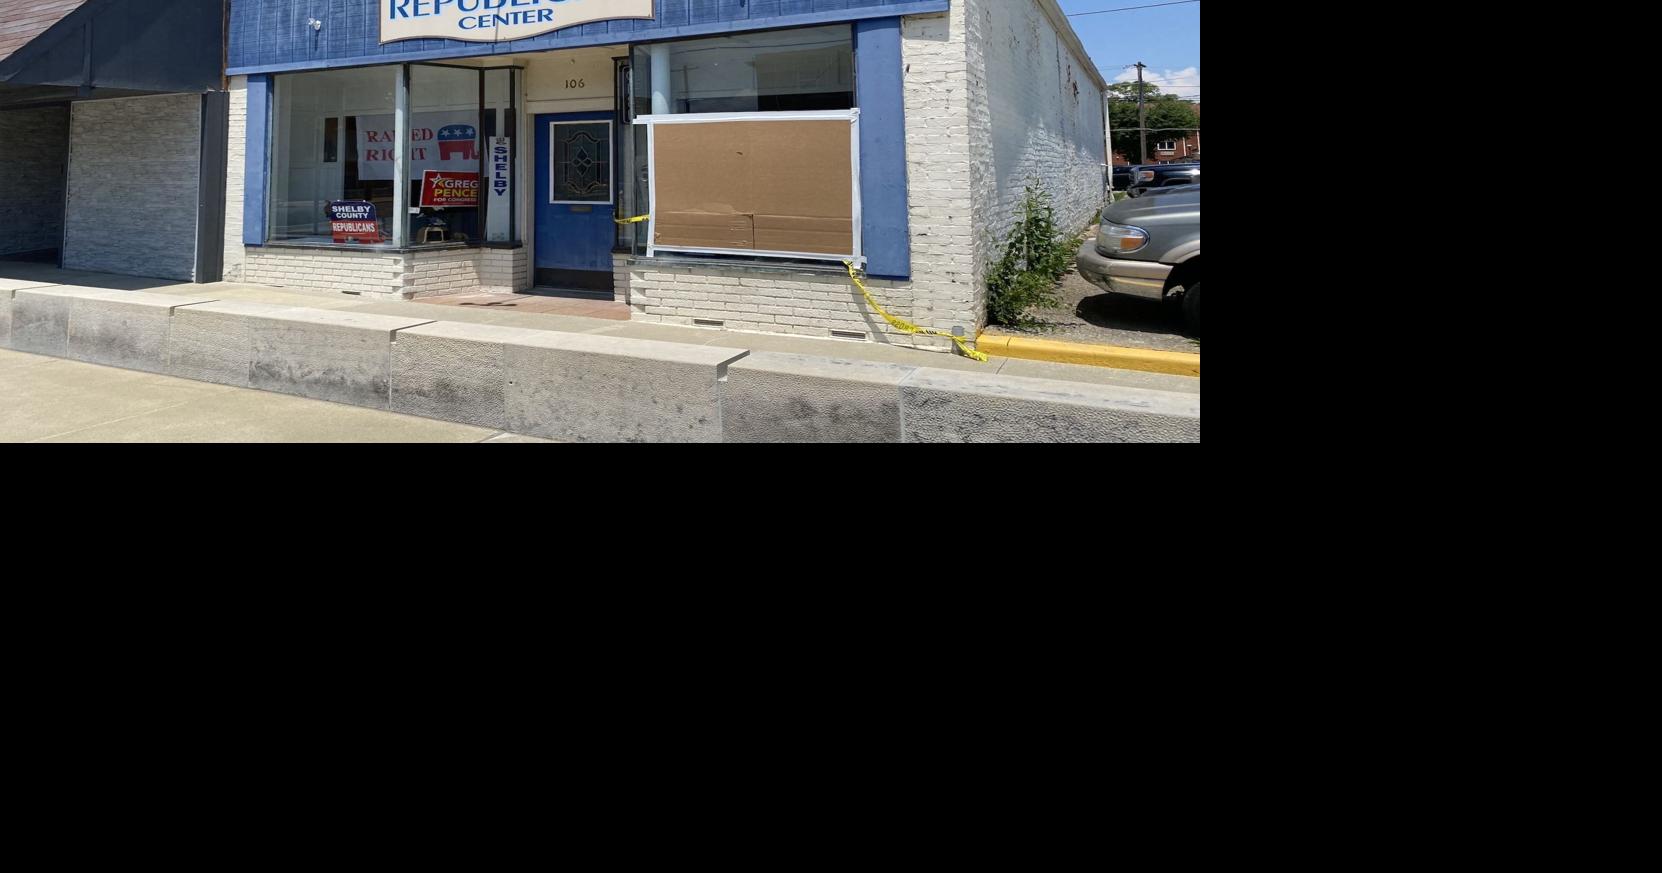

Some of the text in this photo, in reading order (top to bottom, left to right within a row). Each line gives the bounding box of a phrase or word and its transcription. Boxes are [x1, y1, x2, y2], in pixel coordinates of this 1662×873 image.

[458, 9, 554, 30] CENTER
[565, 78, 585, 89] 106
[366, 128, 434, 143] RAED
[366, 147, 427, 161] RIT
[494, 146, 508, 196] SHELBY
[444, 180, 479, 188] GREG
[434, 188, 478, 197] PENCE
[332, 205, 371, 213] SHELBY
[332, 222, 376, 232] REPUBLICANS
